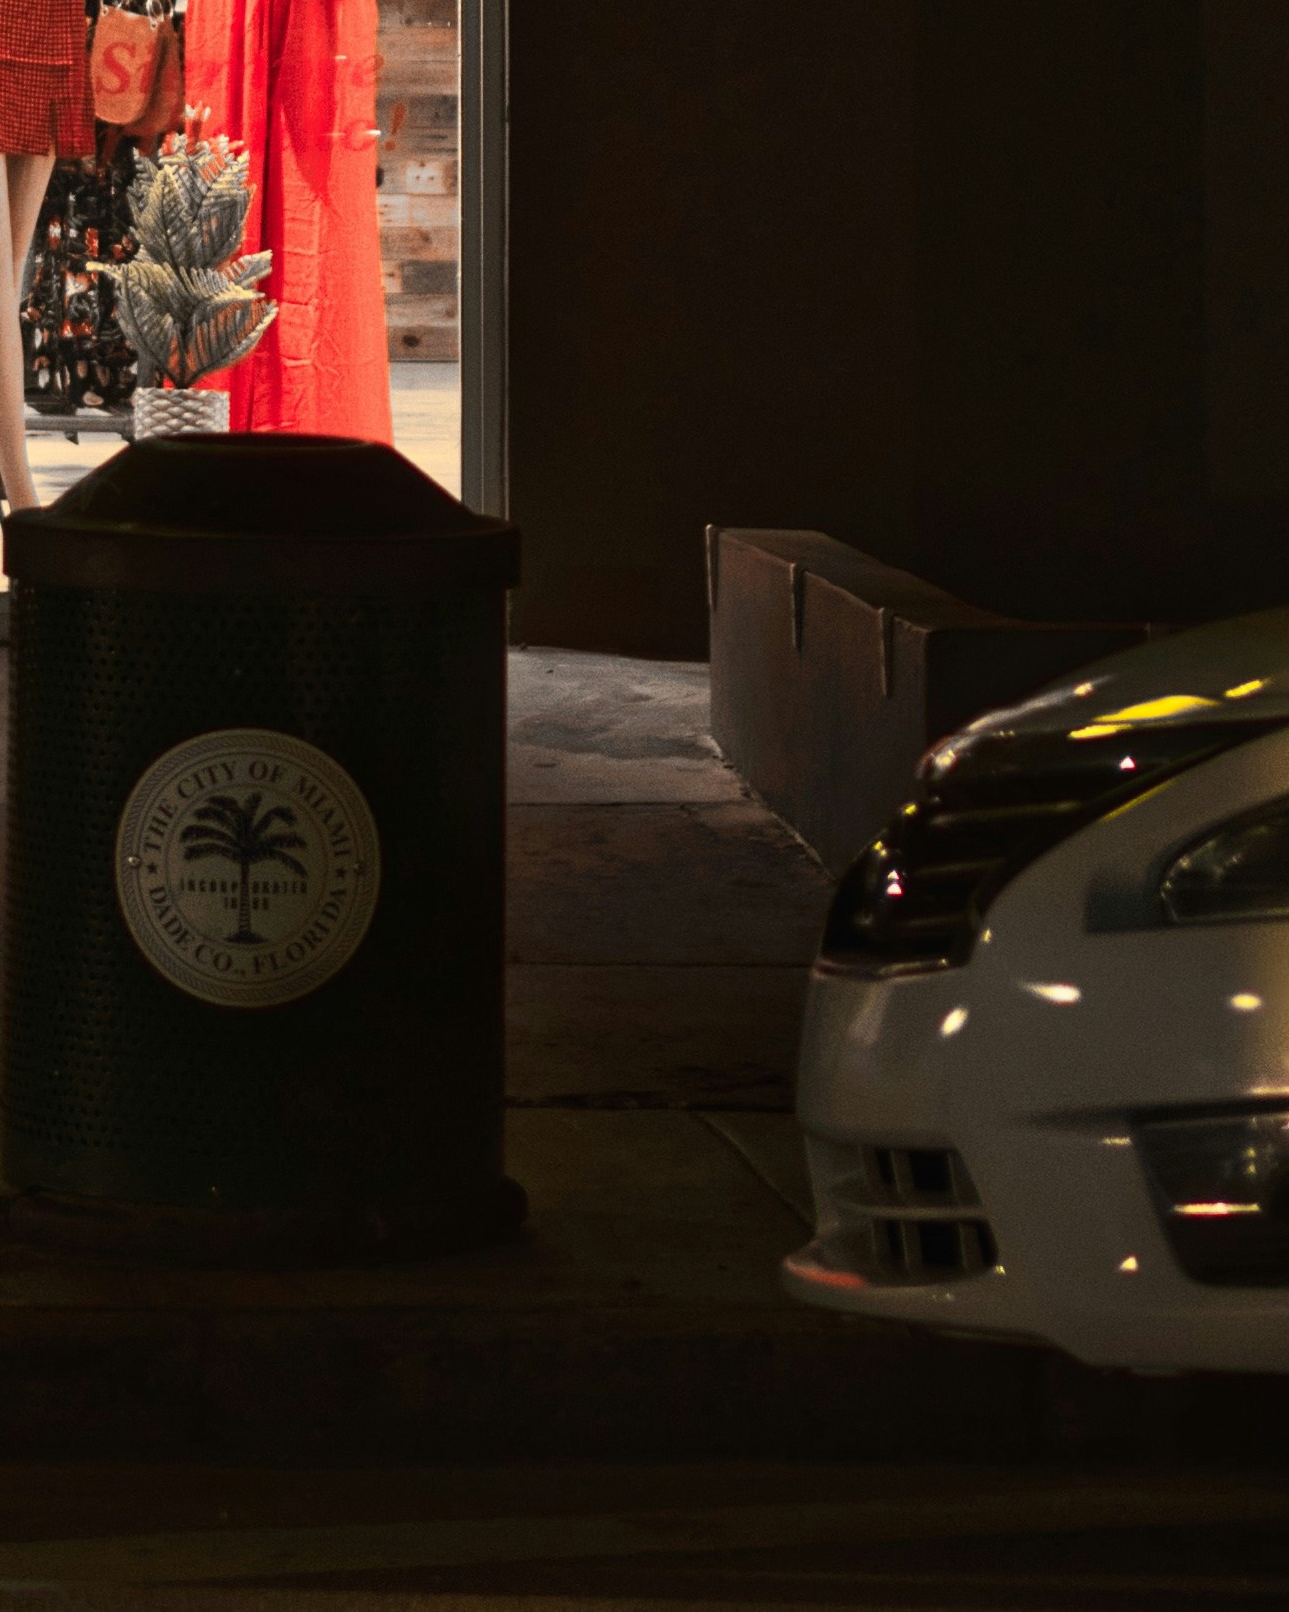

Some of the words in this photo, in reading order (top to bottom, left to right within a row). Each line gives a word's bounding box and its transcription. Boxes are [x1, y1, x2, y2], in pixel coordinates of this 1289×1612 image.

[144, 801, 179, 854] THE
[177, 760, 240, 801] CITY
[249, 759, 286, 784] OF
[296, 775, 351, 858] MIAMI
[148, 884, 197, 953] DADE
[253, 886, 348, 975] FLORIDA
